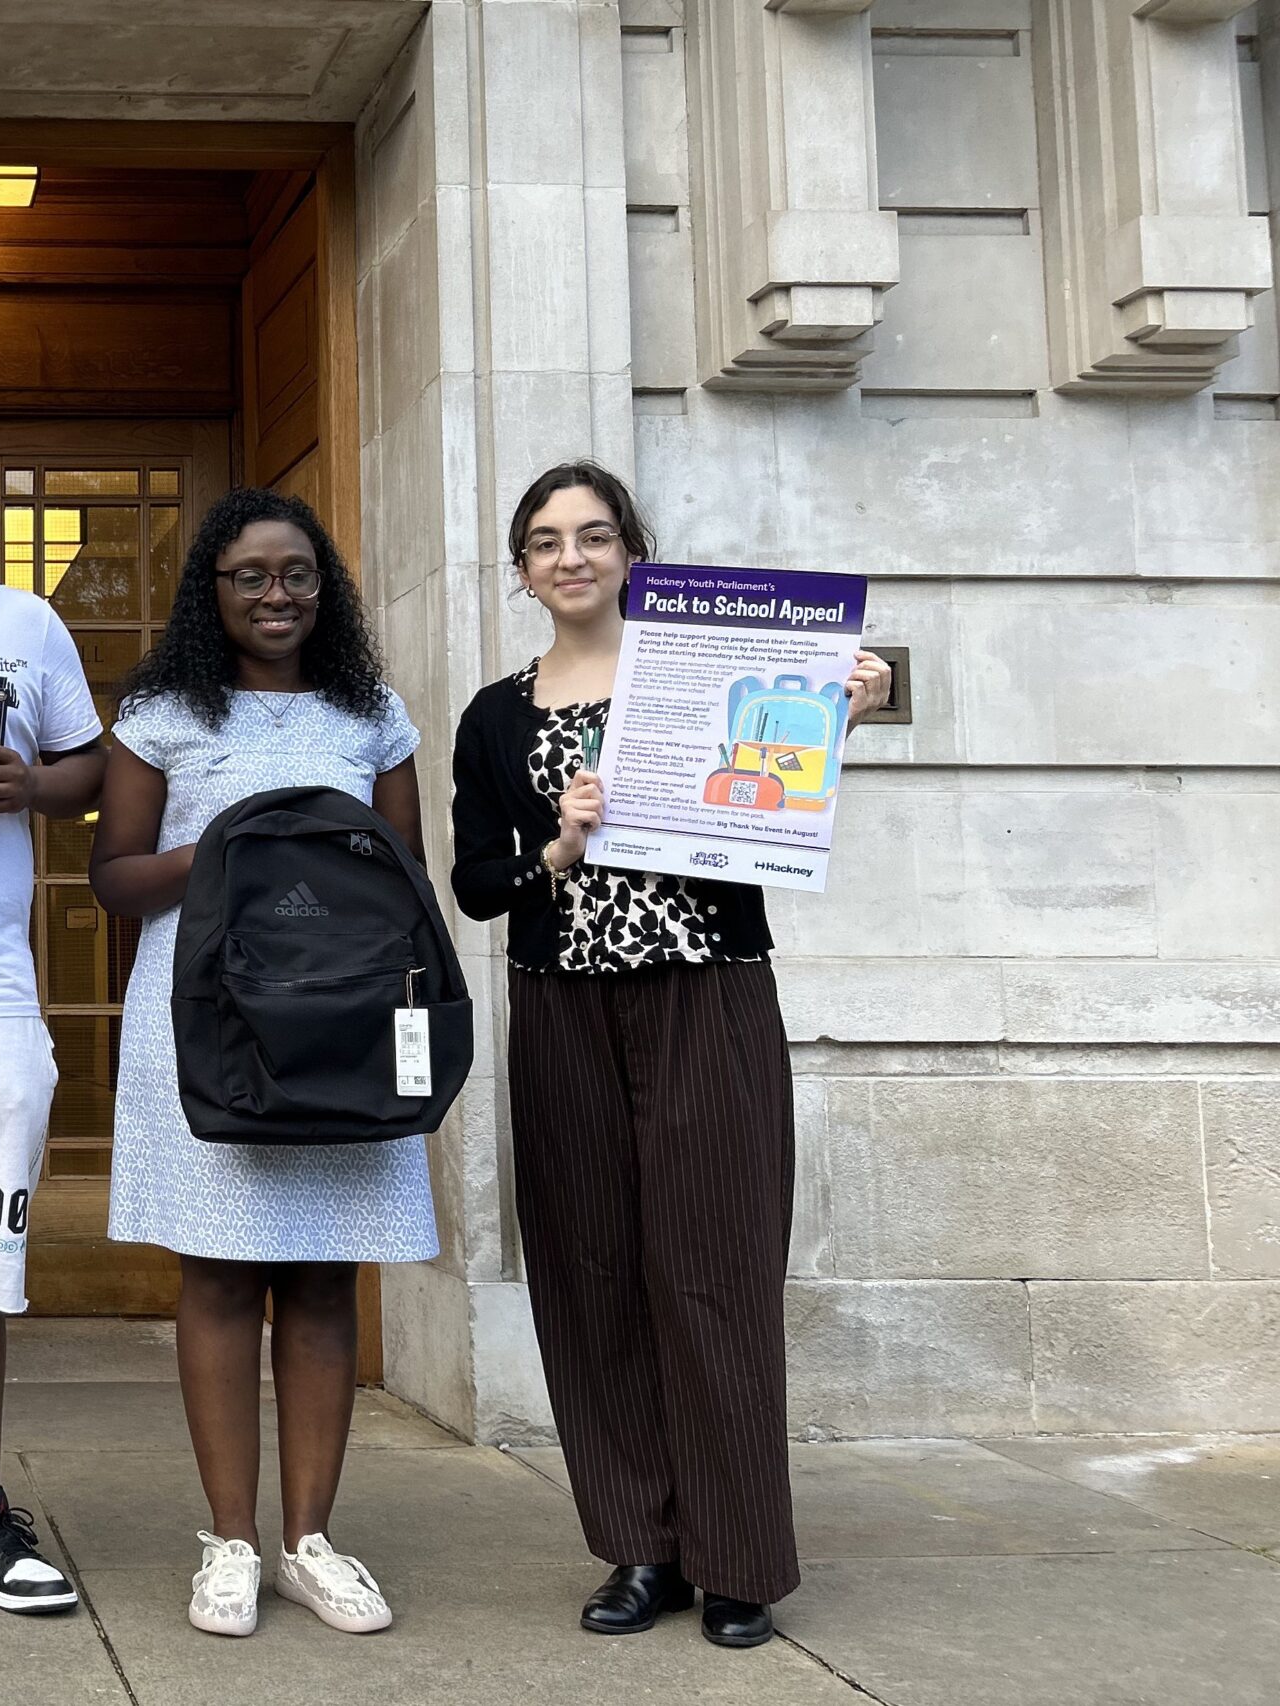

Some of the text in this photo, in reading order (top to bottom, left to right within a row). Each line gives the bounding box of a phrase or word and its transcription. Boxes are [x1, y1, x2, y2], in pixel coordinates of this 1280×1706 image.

[646, 576, 774, 590] Hackney Youth Parliament's
[644, 592, 843, 625] Pack to School Appeal
[749, 646, 781, 654] donating
[766, 862, 812, 876] Hackney
[274, 904, 329, 917] adidas
